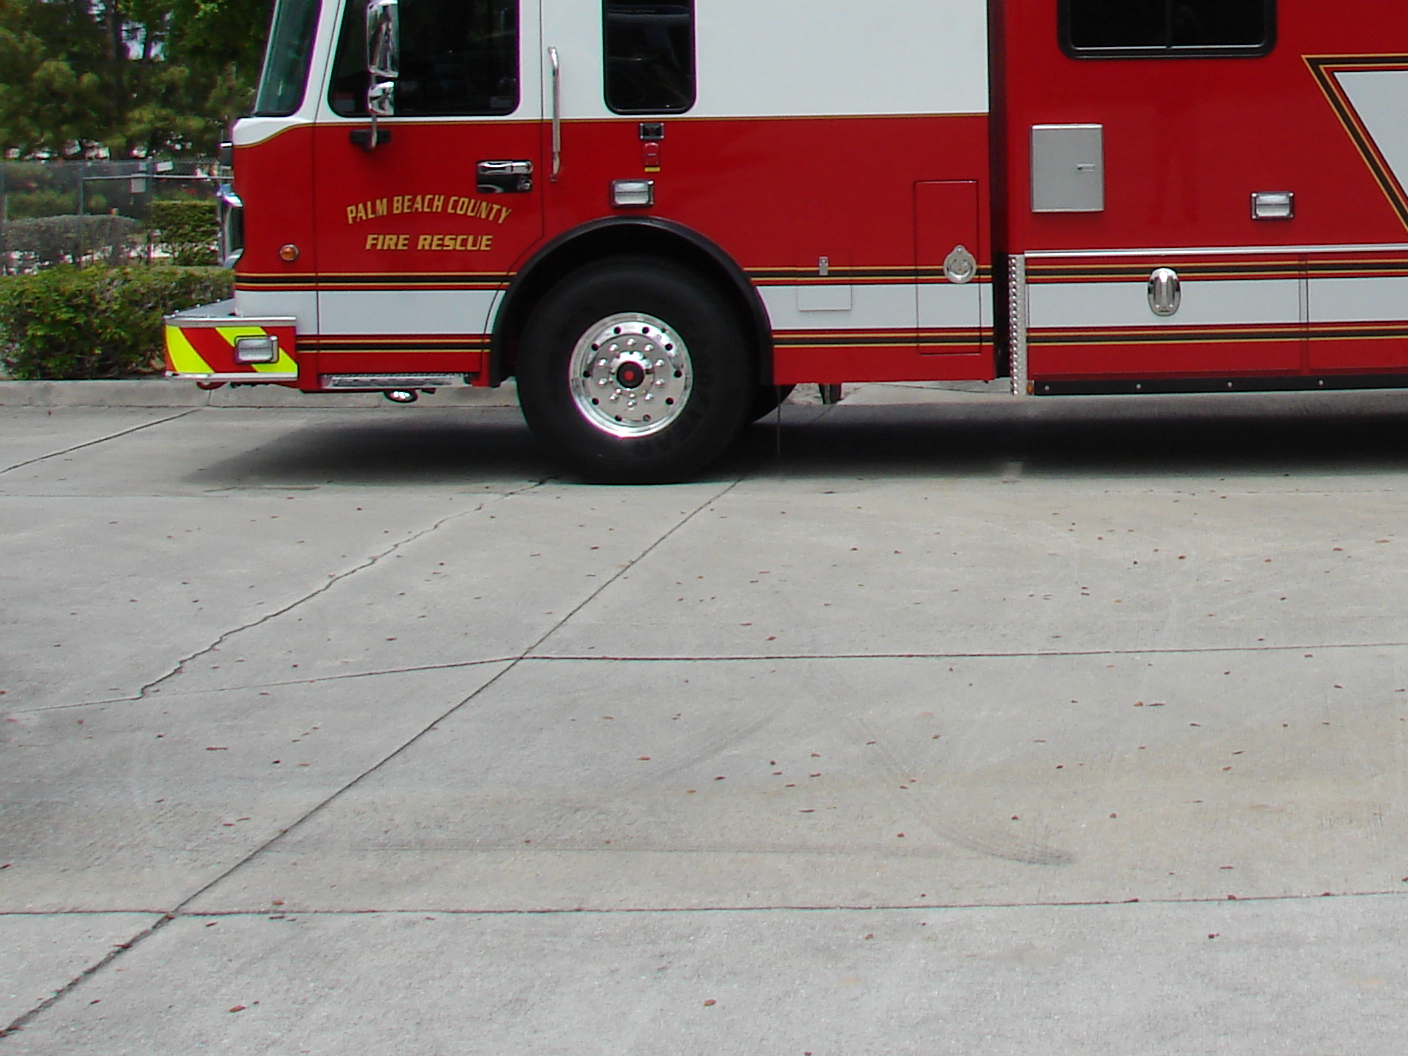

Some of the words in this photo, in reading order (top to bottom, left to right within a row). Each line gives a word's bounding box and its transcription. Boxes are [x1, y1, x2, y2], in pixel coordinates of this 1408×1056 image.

[346, 198, 388, 224] PALM
[392, 194, 445, 213] BEACH
[447, 195, 512, 224] COUNTY
[365, 234, 410, 250] FIRE
[417, 234, 493, 251] RESCUE
